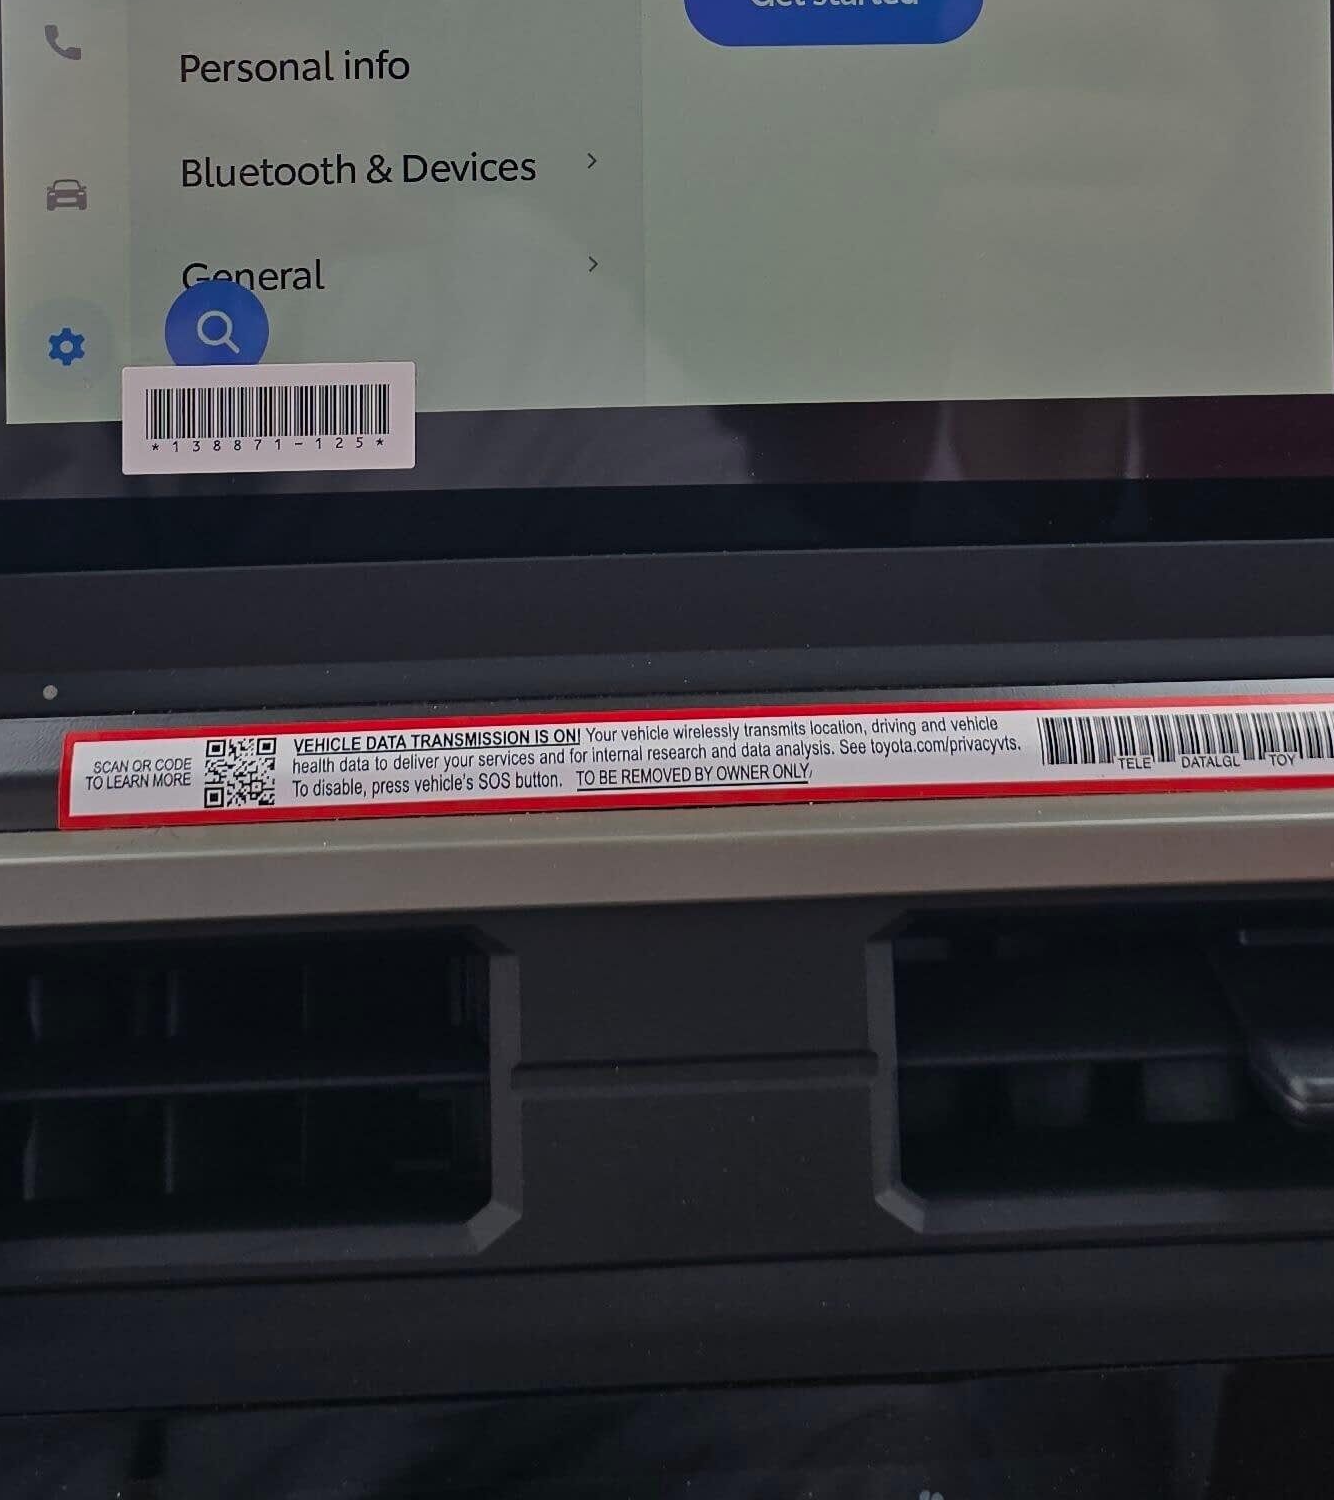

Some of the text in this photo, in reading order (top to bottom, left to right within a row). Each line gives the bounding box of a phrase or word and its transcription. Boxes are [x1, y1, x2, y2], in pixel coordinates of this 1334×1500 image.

[179, 49, 410, 83] Personal info
[182, 151, 536, 187] Bluetooth & Devices
[294, 715, 998, 752] VEHICLE DATA TRANSMISSION IS ON! Your vehicle wirelessly transmits location, driving and vehicle
[94, 760, 129, 774] SCAN
[155, 758, 192, 771] CODE
[292, 736, 1021, 774] health data to deliver your services and for internal research and data analysis. See toyota.com/privacyvts.
[1118, 754, 1297, 769] TELE DATALGL TOY
[86, 772, 191, 790] TO LEARN MORE
[292, 780, 308, 797] To
[313, 778, 366, 798] disable,
[372, 779, 410, 798] press
[415, 775, 474, 793] vehicle's
[478, 772, 510, 789] SOS
[516, 771, 562, 788] button.
[576, 771, 595, 786] TO
[599, 770, 617, 785] BE
[621, 767, 691, 784] REMOVED
[695, 766, 712, 782] BY
[716, 764, 769, 781] OWNER
